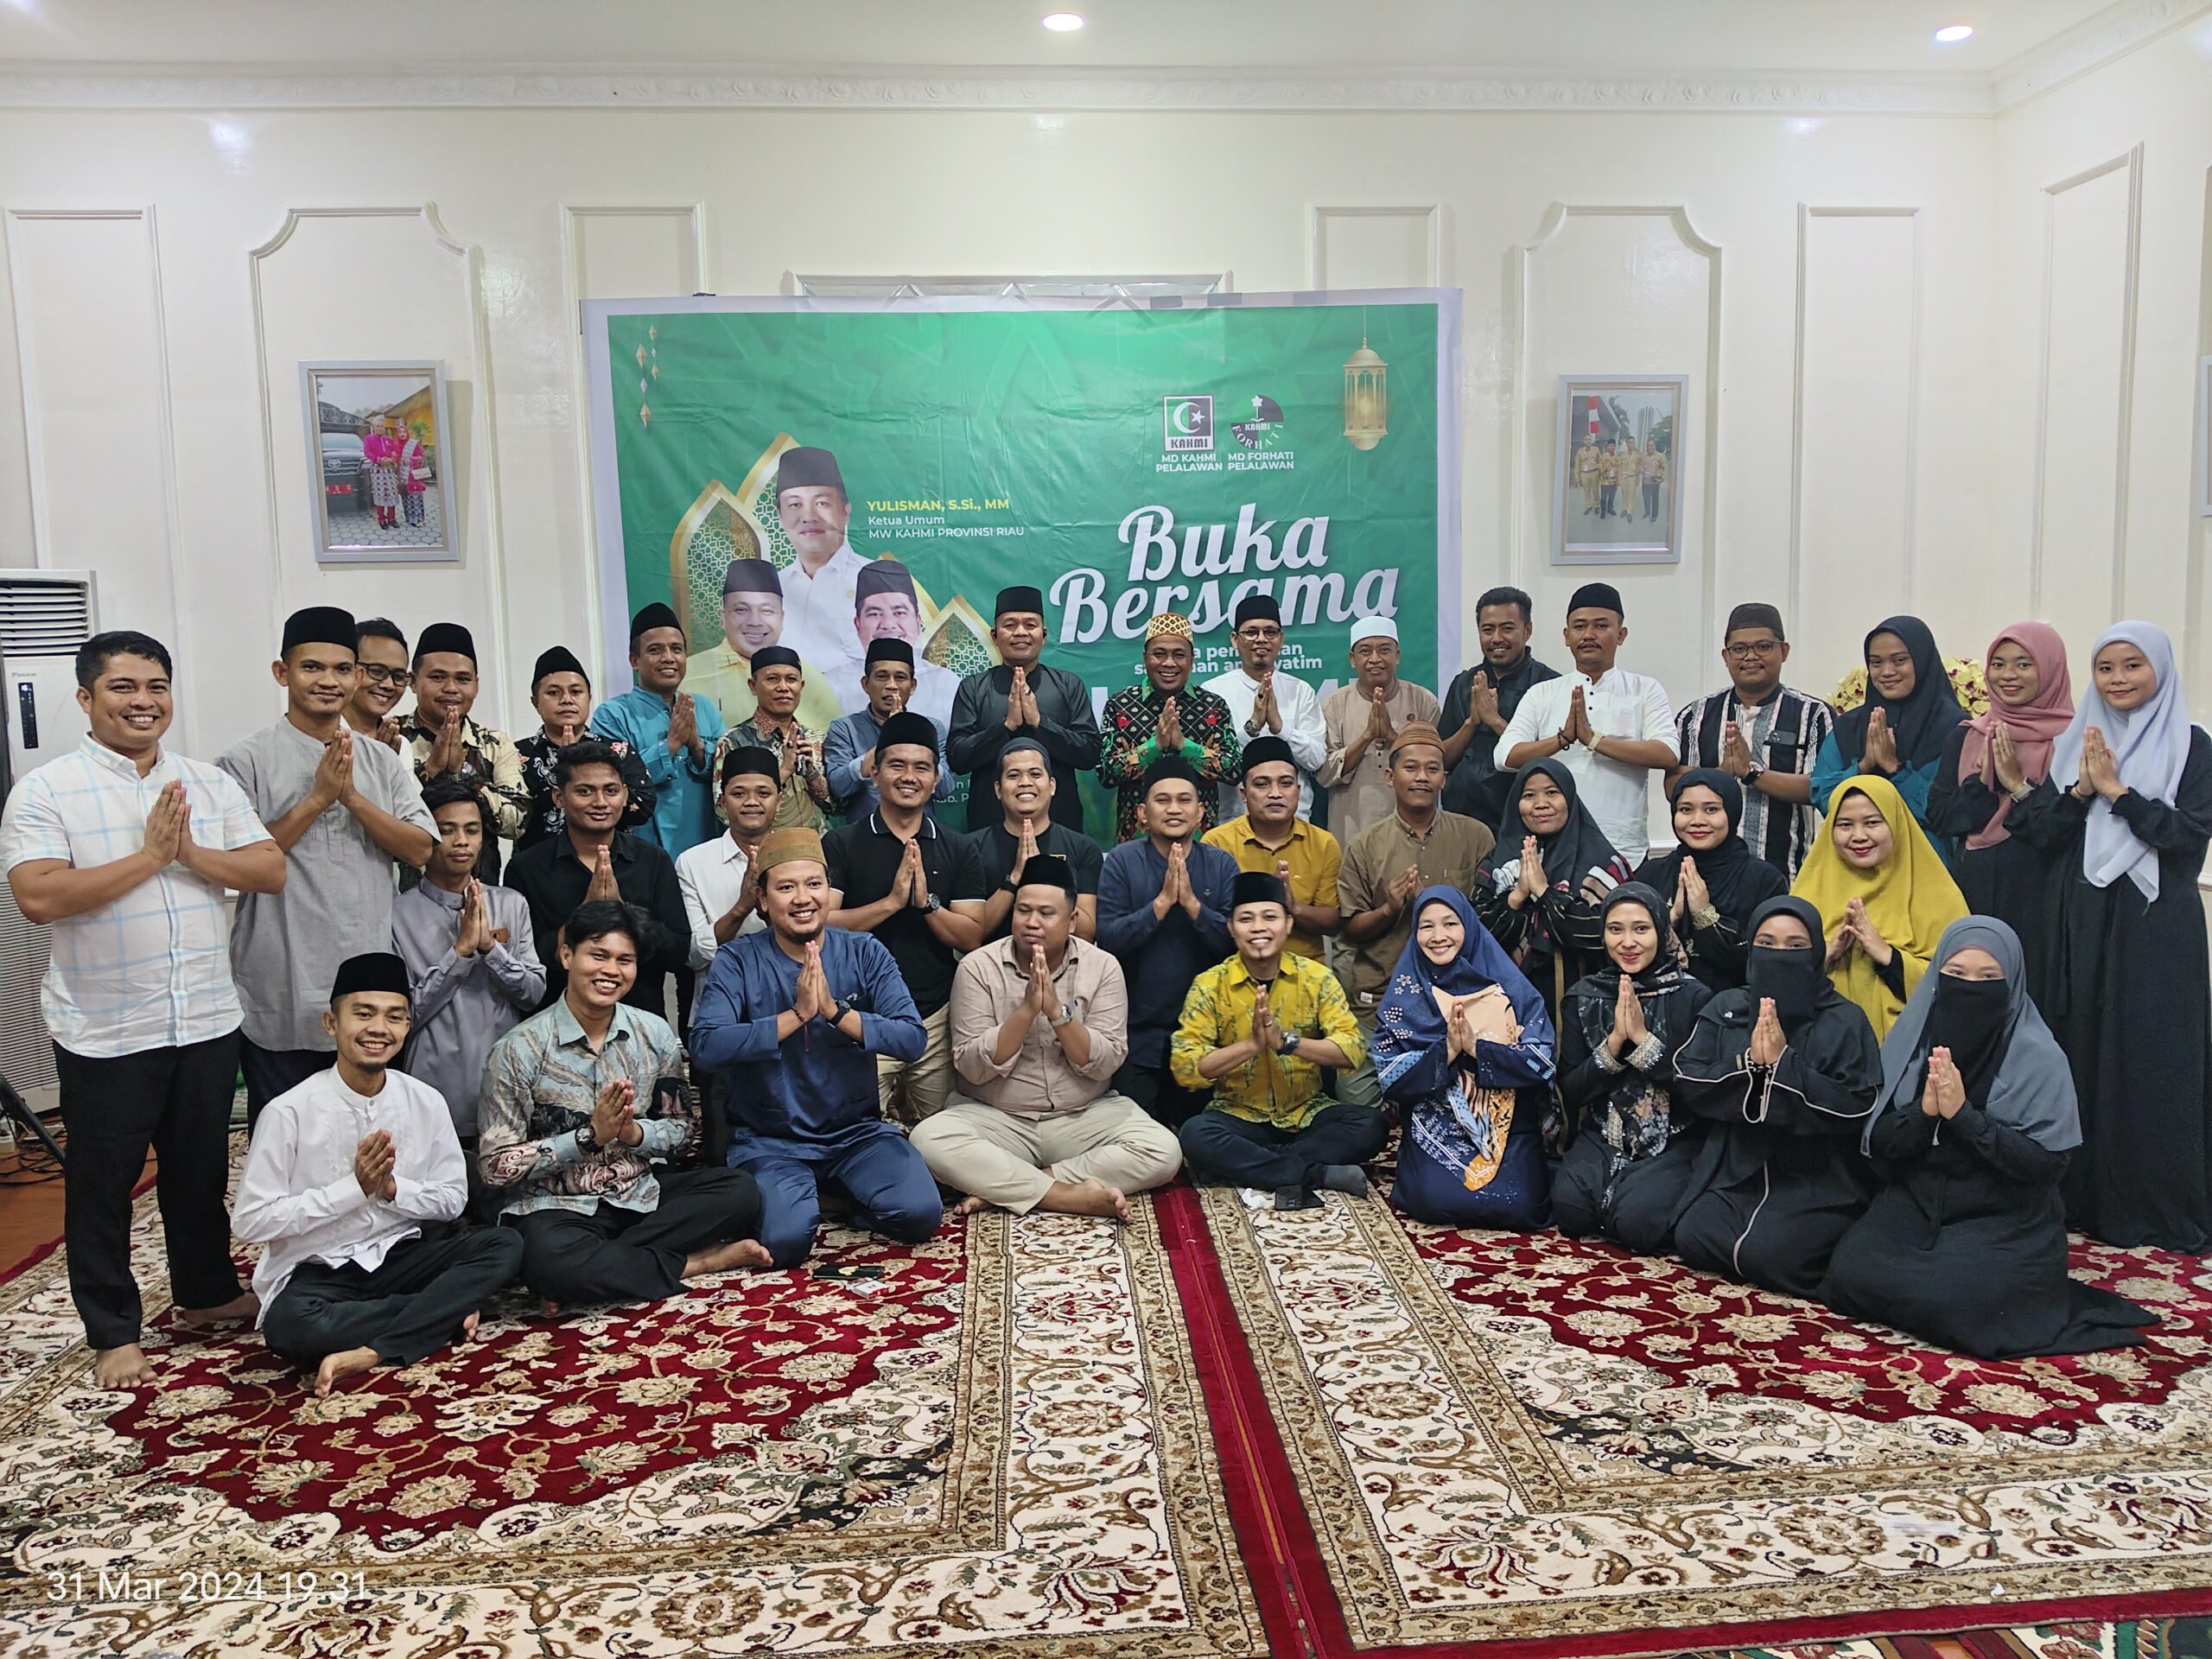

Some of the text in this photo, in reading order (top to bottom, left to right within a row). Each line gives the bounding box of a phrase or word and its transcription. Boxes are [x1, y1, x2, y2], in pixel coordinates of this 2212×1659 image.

[1244, 423, 1270, 431] KAHMI
[1171, 438, 1208, 448] KAHMI
[1161, 453, 1217, 463] MD KAHMI
[1228, 451, 1294, 461] MD FORHATI
[1156, 462, 1223, 473] PELALAWAN
[1228, 461, 1294, 471] PELALAWAN
[867, 498, 1010, 512] YULISMAN, S.Si., MM
[868, 515, 945, 525] Ketua Umum
[868, 526, 1025, 539] MW KAHMI PROVINSI RIAU
[1117, 502, 1330, 582] Buka
[1049, 567, 1400, 645] Bersama
